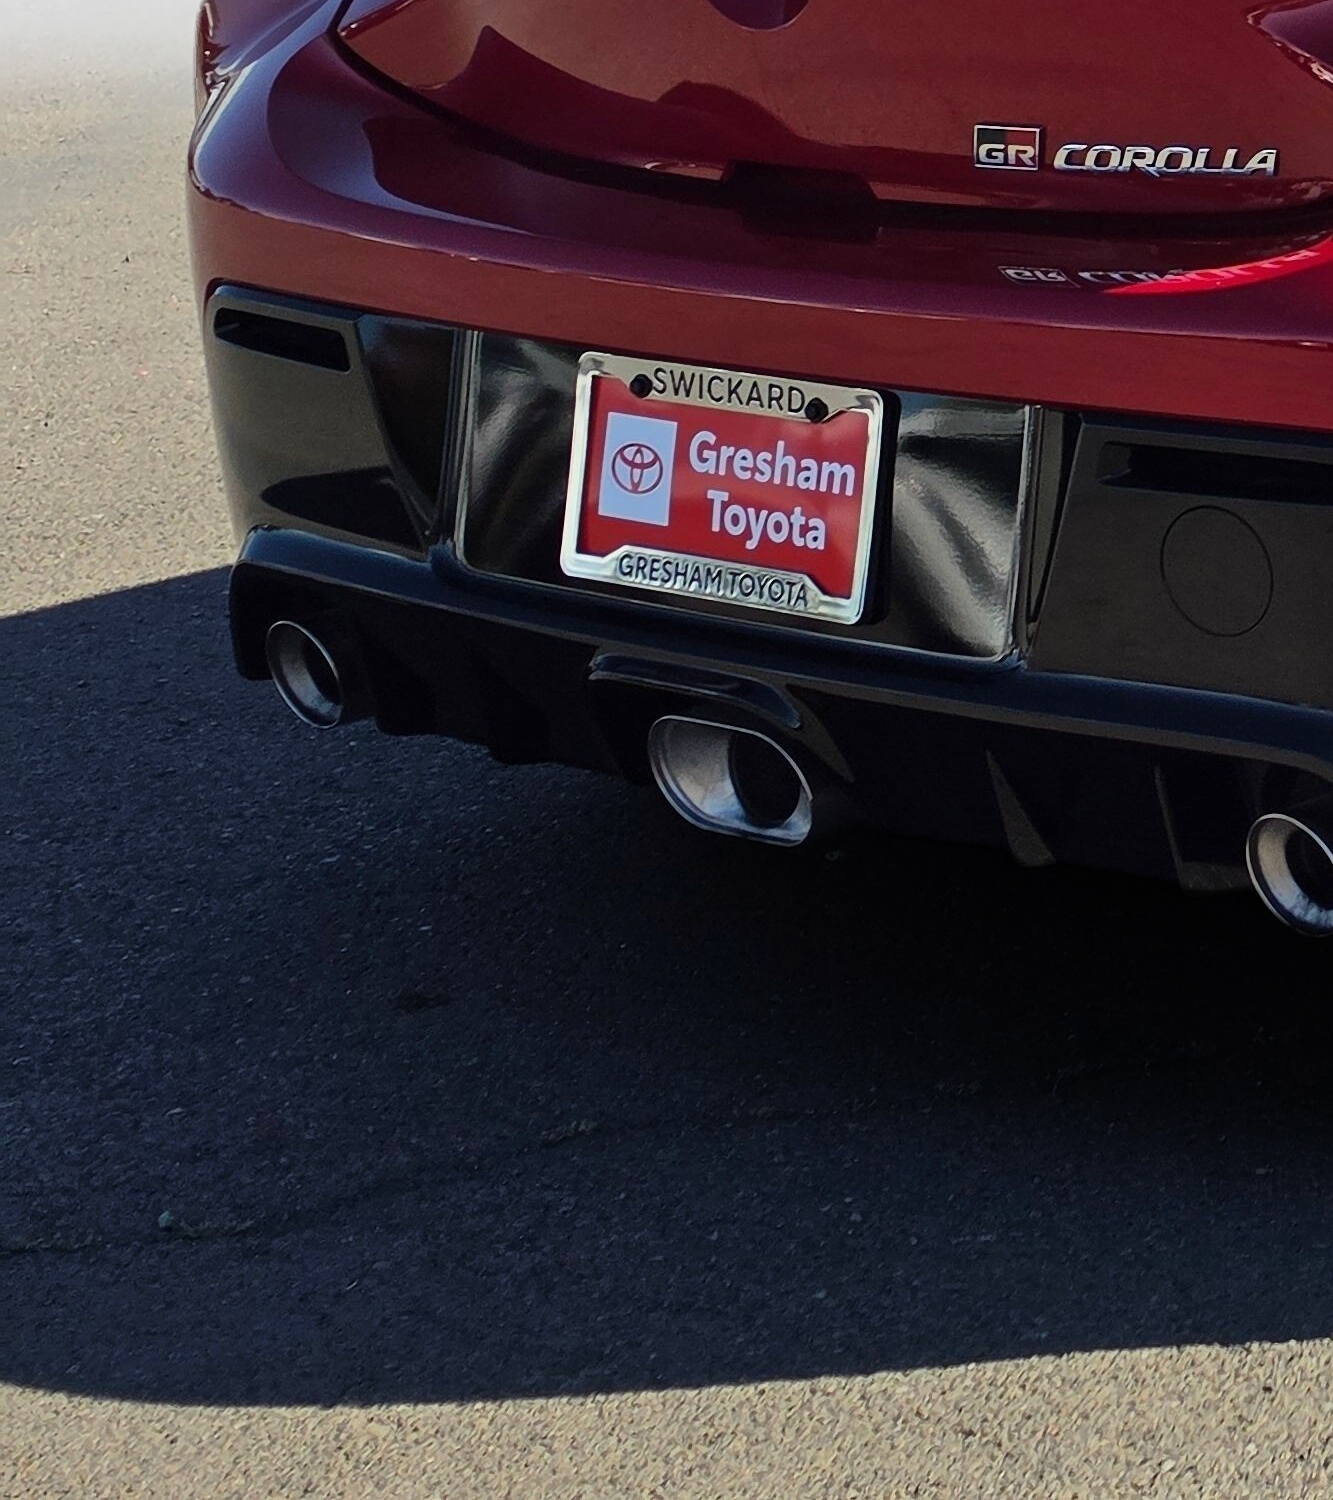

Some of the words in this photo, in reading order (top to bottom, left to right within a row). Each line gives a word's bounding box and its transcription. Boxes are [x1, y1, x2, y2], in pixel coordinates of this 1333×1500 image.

[978, 143, 1035, 166] GR
[1053, 144, 1278, 177] COROLLA
[651, 367, 806, 414] SWICKARD
[689, 430, 856, 497] Gresham
[707, 489, 827, 550] Toyota
[618, 553, 724, 594] GRESHAM
[727, 571, 810, 608] TOYOTA
